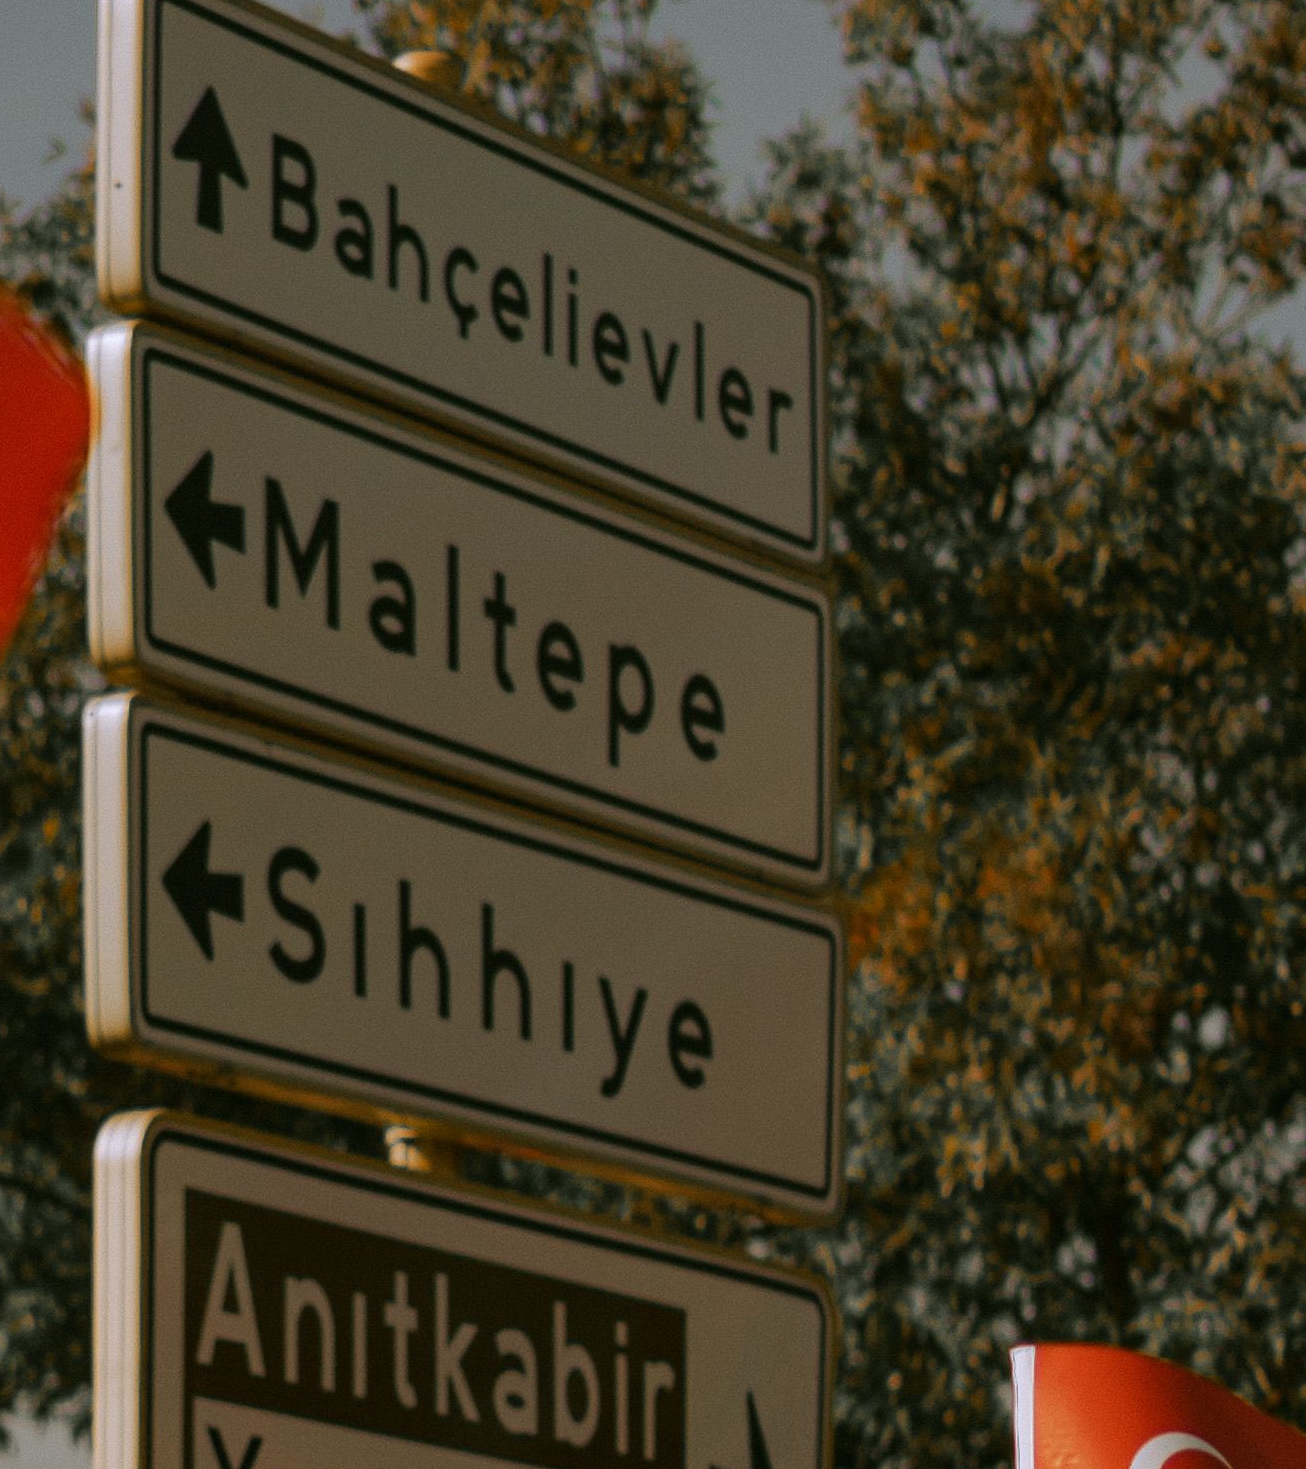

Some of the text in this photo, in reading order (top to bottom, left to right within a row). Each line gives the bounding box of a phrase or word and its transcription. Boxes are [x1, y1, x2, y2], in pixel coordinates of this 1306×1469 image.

[271, 133, 794, 454] Bahçelievler
[265, 475, 726, 767] Maltepe
[267, 846, 713, 1098] Sıhhıye
[196, 1221, 675, 1461] Anıtkabir
